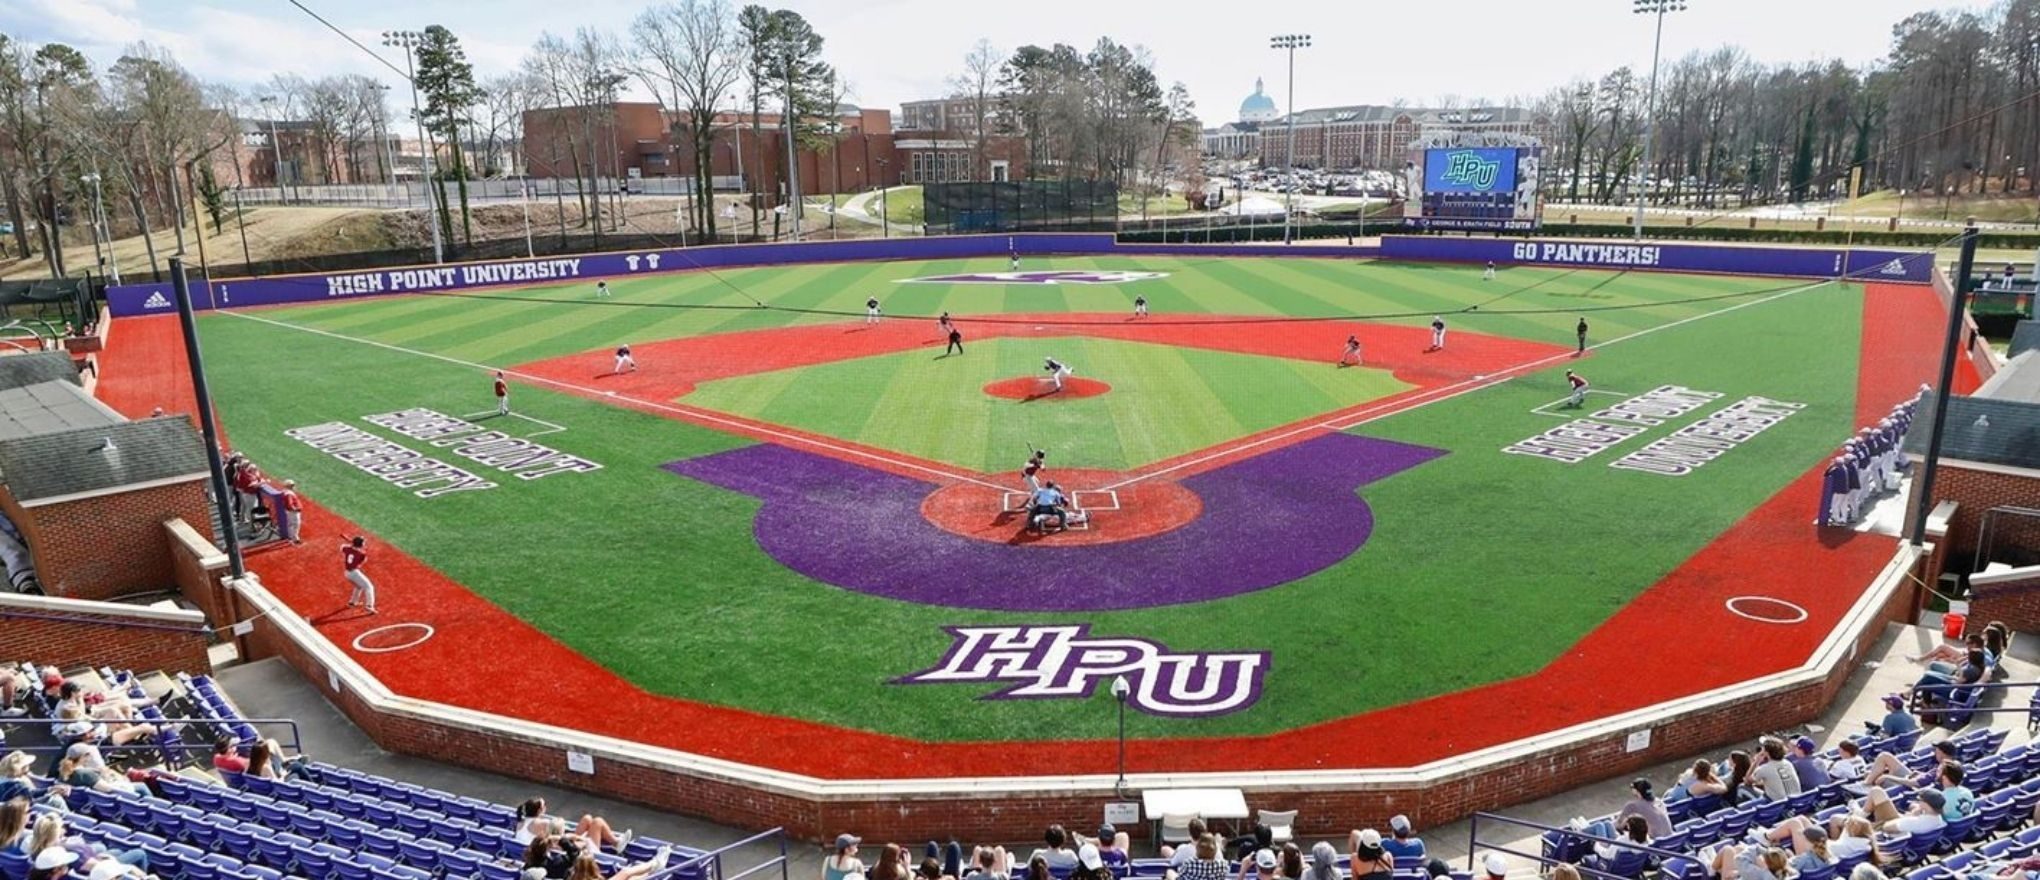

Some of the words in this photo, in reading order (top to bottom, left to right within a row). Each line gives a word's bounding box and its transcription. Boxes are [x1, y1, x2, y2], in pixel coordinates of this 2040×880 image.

[1441, 150, 1500, 191] HPU
[1504, 220, 1531, 229] SOUTH
[1513, 242, 1537, 260] GO
[1542, 244, 1661, 265] PANTHERS!
[327, 272, 383, 296] HIGH
[390, 267, 456, 290] POINT
[462, 259, 581, 284] UNIVERSITY
[284, 421, 499, 498] UNIVERSITY
[361, 407, 486, 440] HIGH
[430, 431, 604, 480] POINT
[1501, 418, 1648, 463] HIGH
[1589, 384, 1726, 426] POINT
[1608, 395, 1808, 475] UNIVERSITY
[884, 623, 1272, 718] HPU
